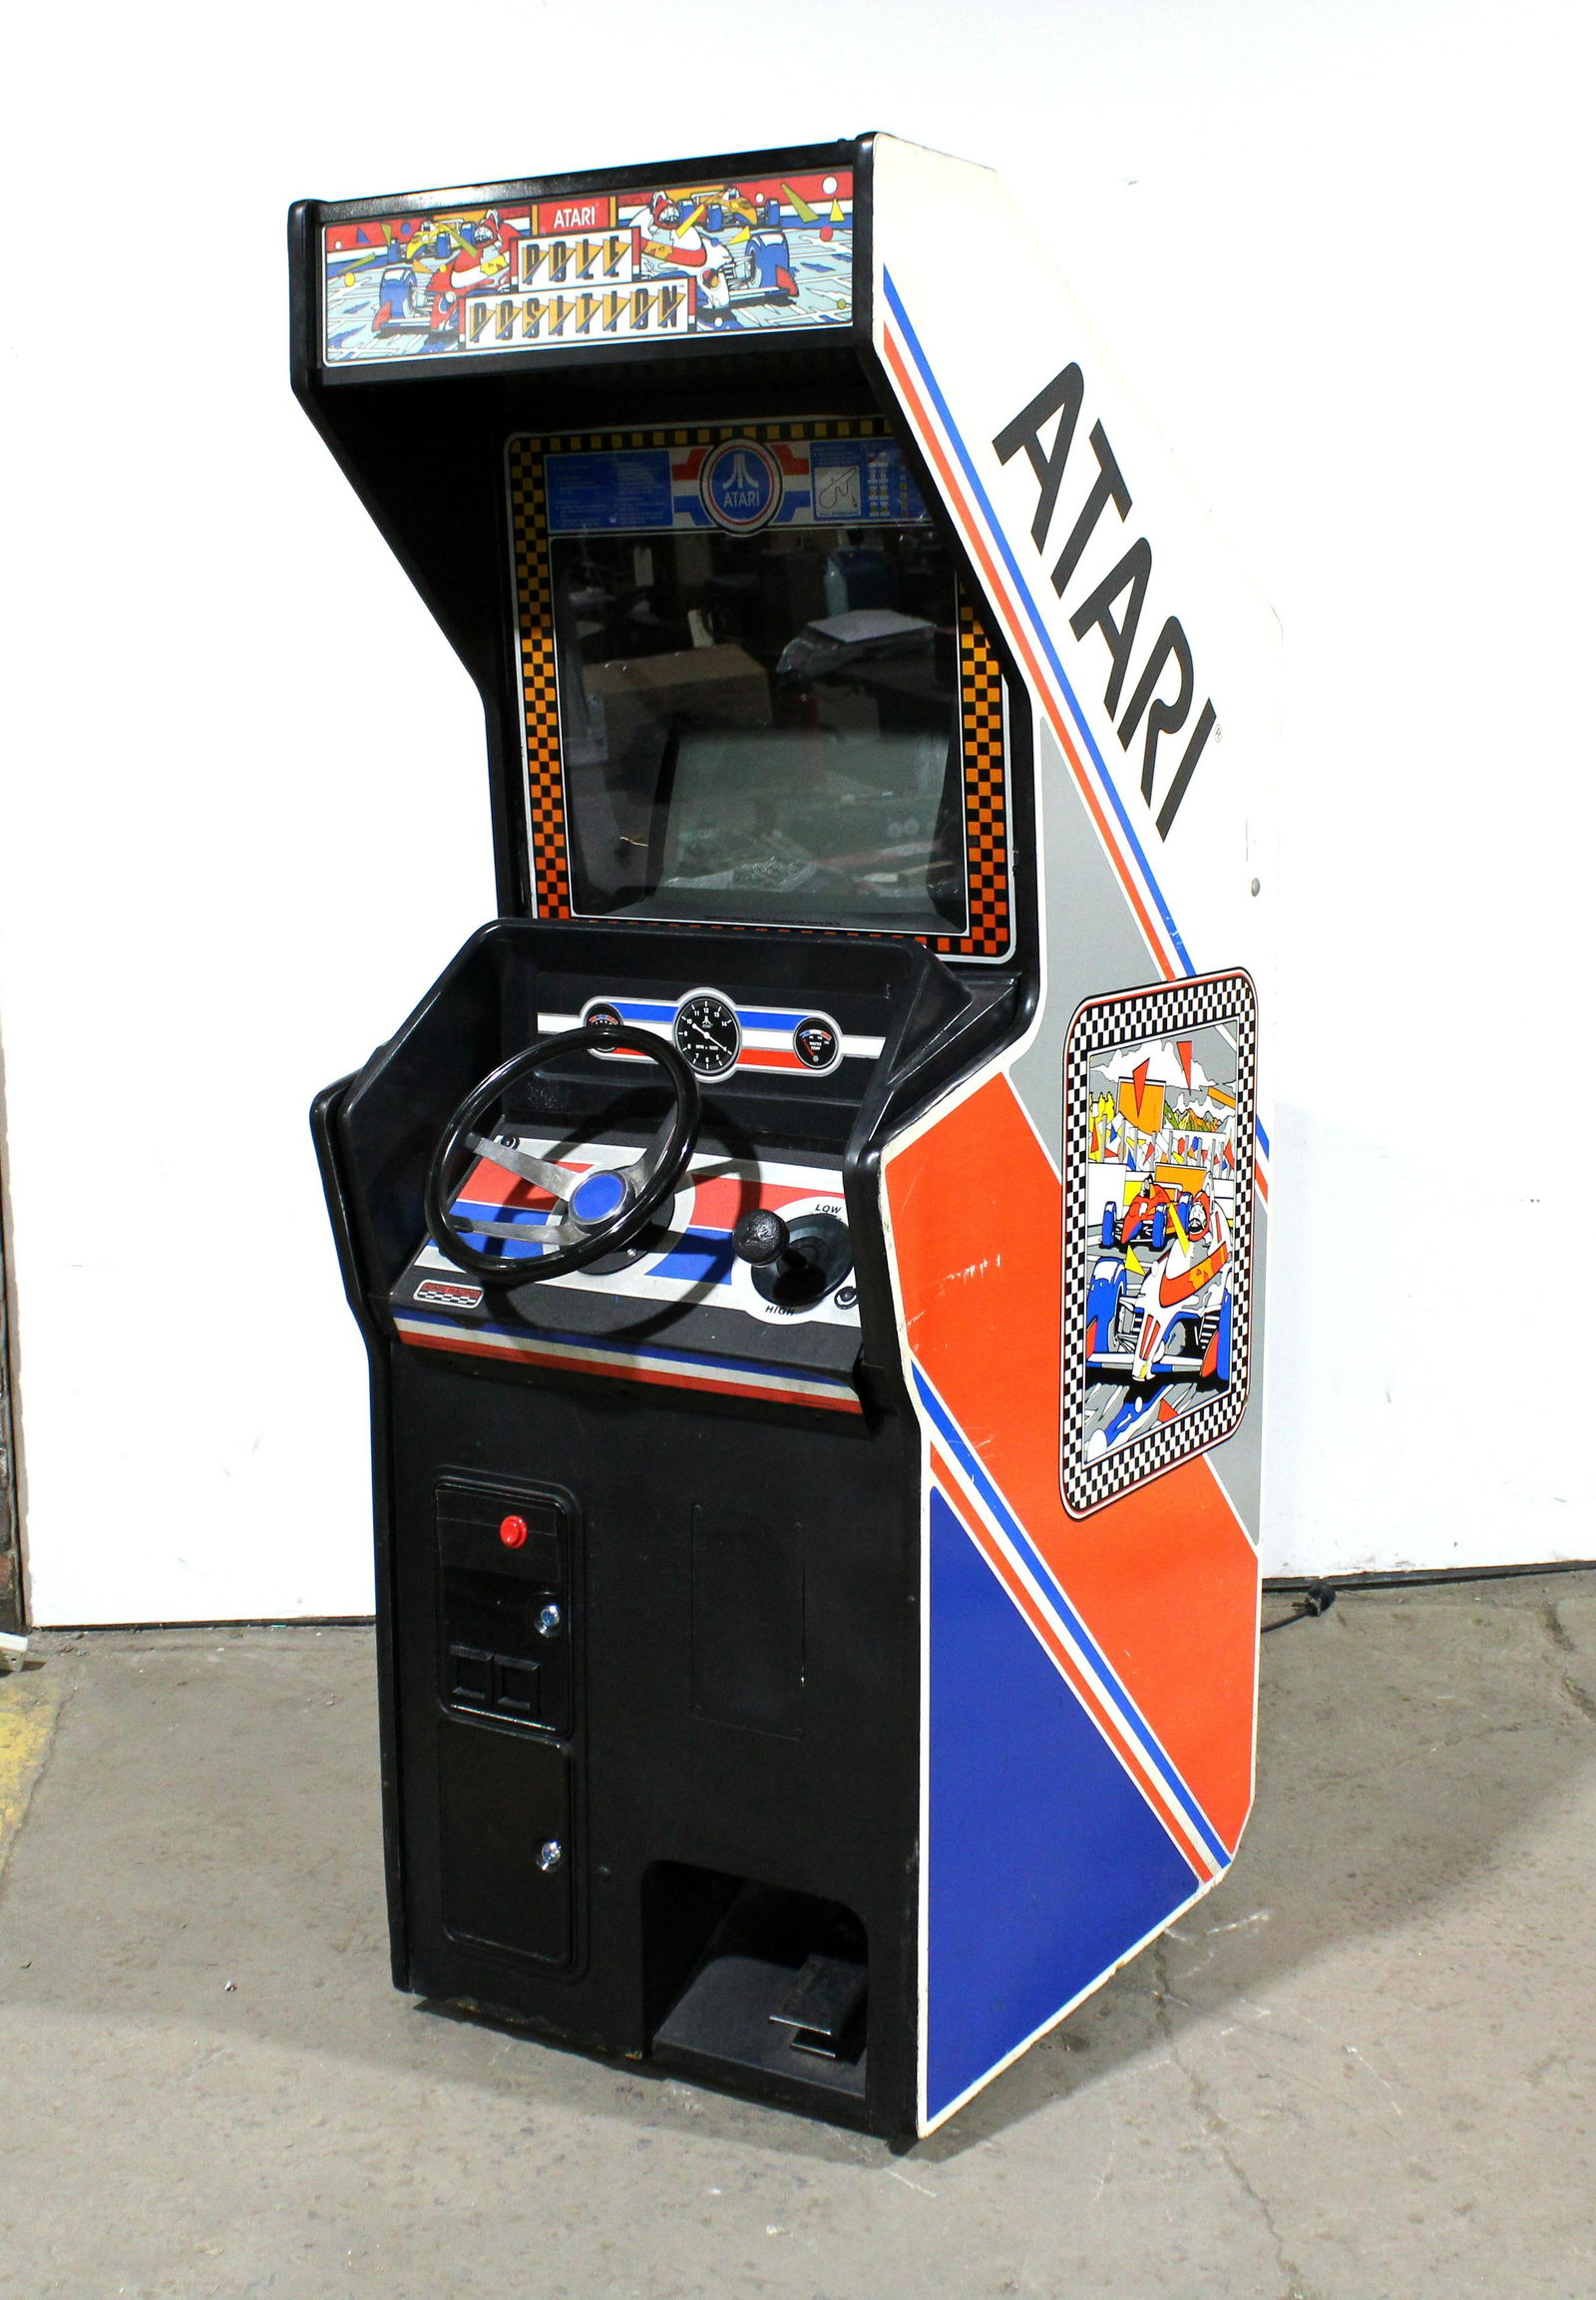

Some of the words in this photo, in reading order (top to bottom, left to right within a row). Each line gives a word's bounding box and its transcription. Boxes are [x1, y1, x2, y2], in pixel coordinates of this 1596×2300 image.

[554, 205, 597, 229] ATARI
[522, 235, 629, 285] POLE
[469, 285, 686, 343] POSITION
[723, 490, 761, 509] ATARI
[991, 361, 1217, 844] ATARI
[814, 1204, 843, 1214] LOW
[765, 1305, 796, 1317] HIGH
